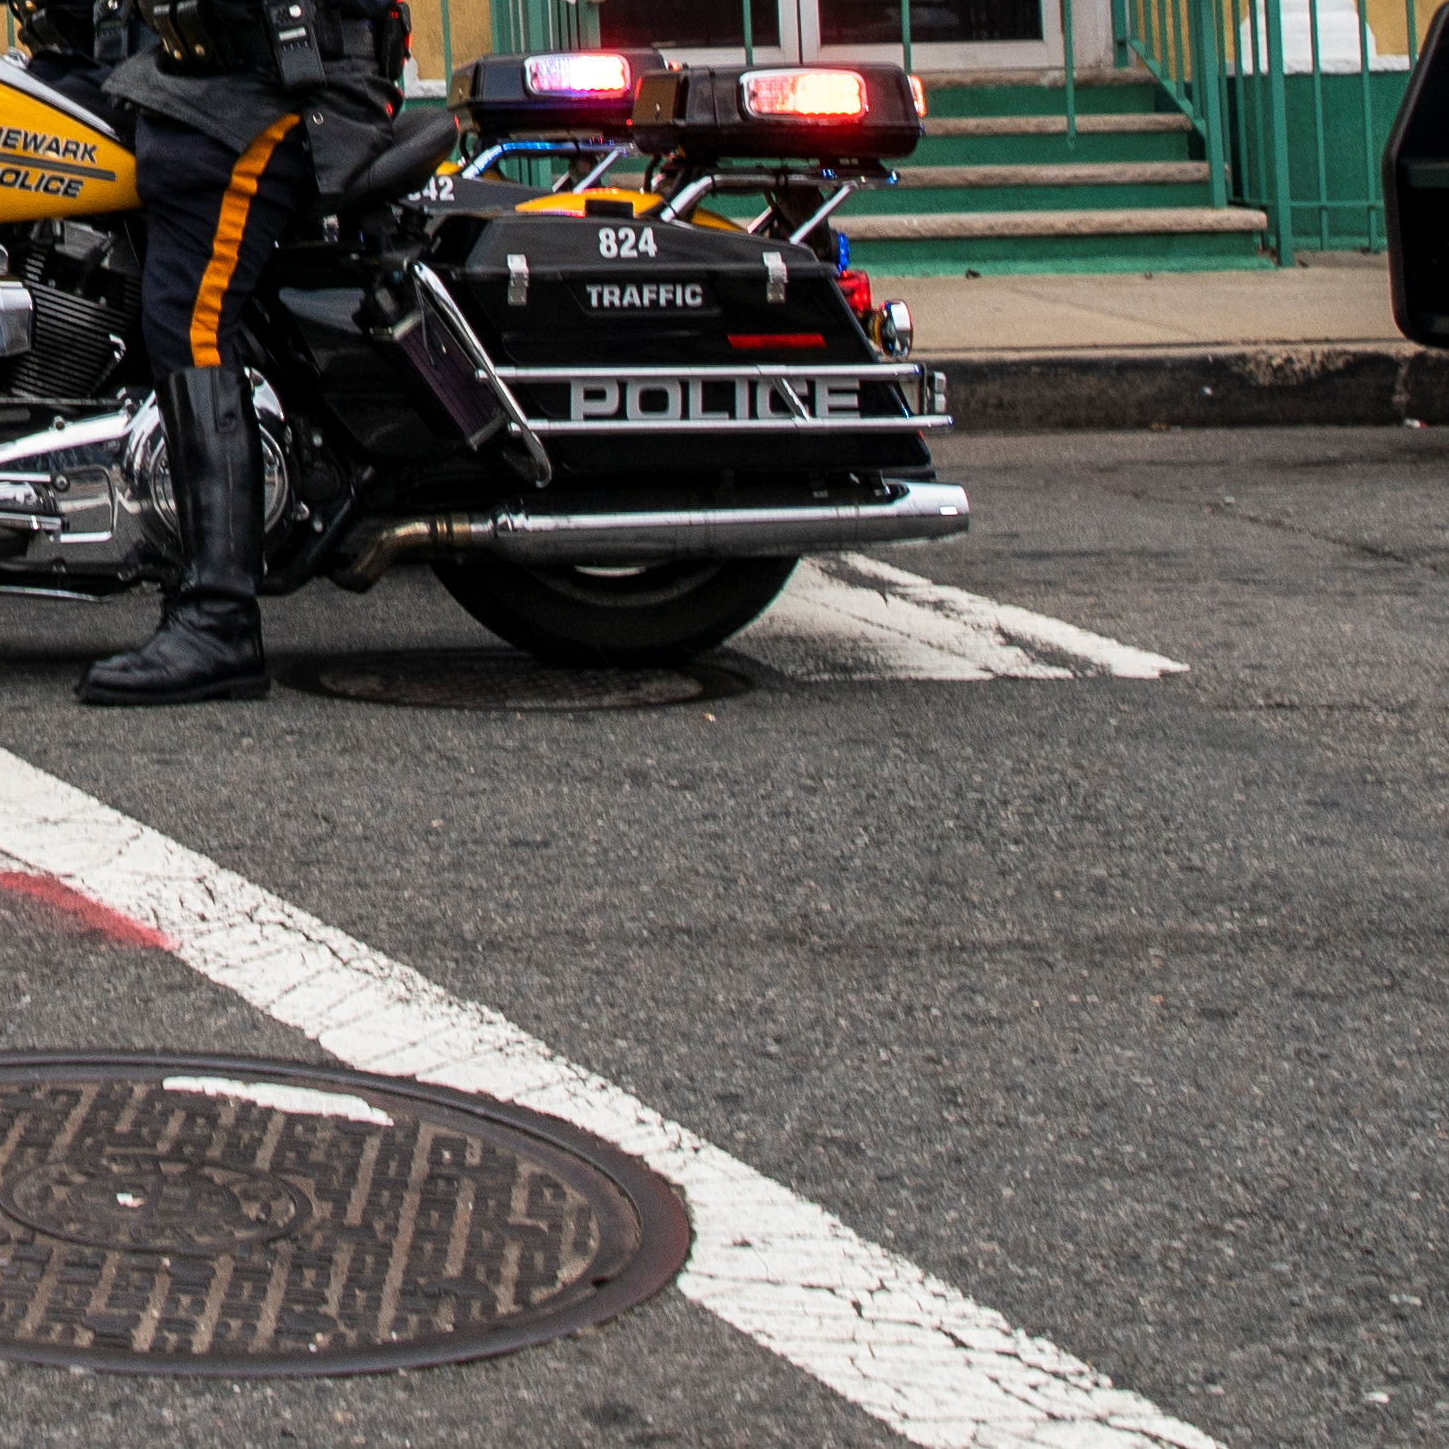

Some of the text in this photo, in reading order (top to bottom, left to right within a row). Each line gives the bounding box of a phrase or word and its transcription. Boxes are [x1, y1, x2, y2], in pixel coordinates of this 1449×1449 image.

[598, 226, 658, 259] 824
[585, 283, 703, 308] TRAFFIC
[570, 376, 861, 421] POLICE
